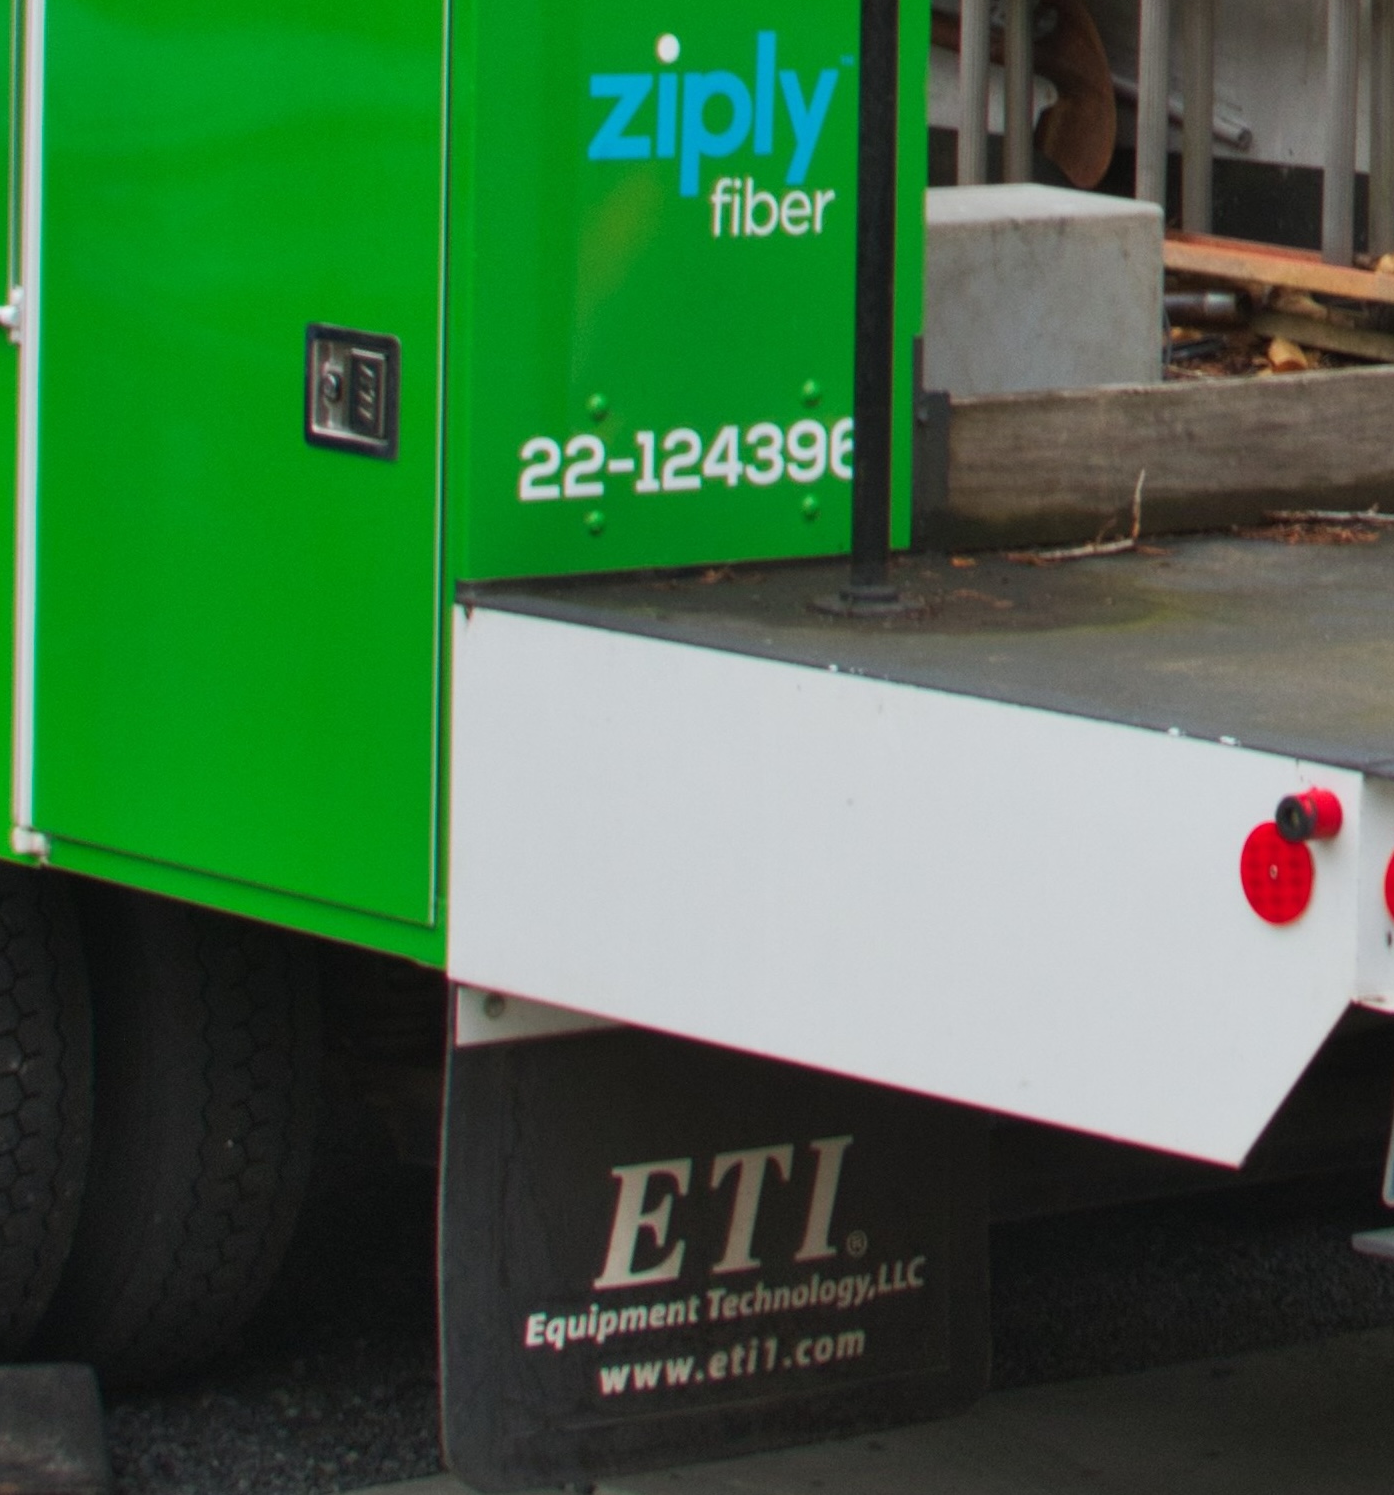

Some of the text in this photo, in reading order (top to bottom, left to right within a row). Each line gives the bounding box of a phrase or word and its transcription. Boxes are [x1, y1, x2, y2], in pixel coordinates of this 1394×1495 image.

[588, 30, 839, 197] ziply
[709, 176, 835, 237] fiber
[593, 1134, 854, 1290] ETI
[524, 1294, 701, 1350] Equipment
[600, 1329, 866, 1396] www.eti1.com
